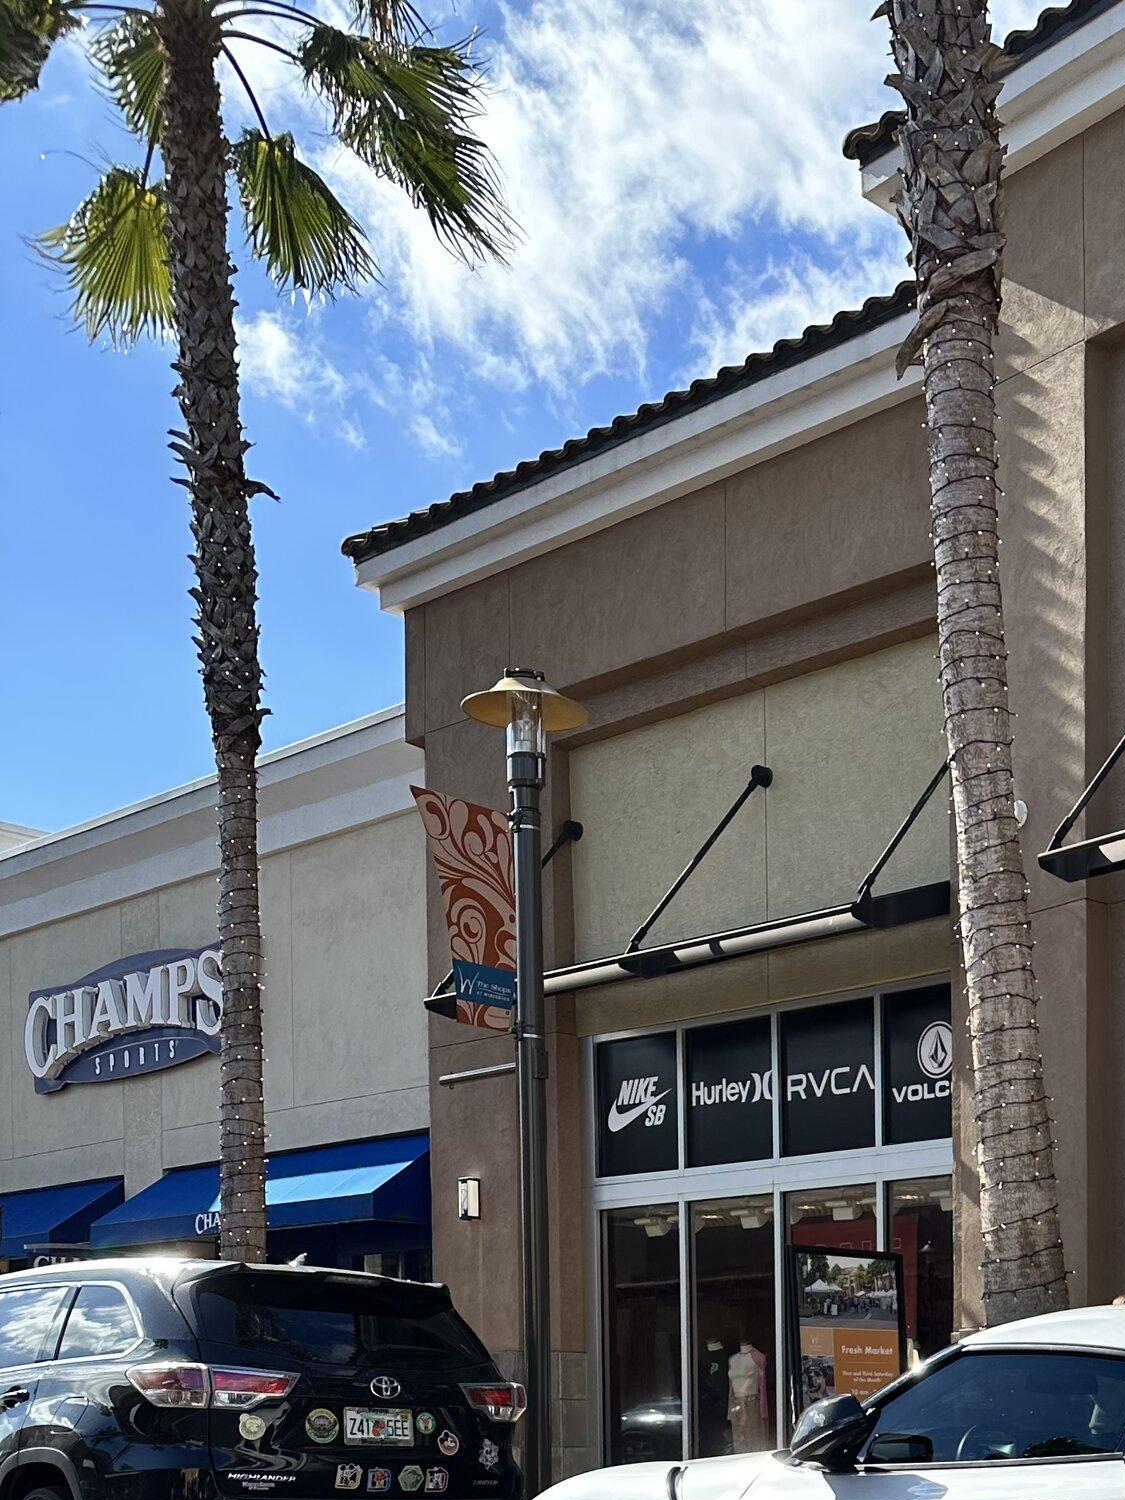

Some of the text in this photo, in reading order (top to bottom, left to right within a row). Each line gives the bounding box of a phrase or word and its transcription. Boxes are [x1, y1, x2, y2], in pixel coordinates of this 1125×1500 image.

[95, 1039, 176, 1075] SPORTS
[617, 1076, 659, 1106] NIKE
[692, 1078, 751, 1107] Hurley
[645, 1104, 667, 1127] SB
[841, 1344, 893, 1356] Fresh Market
[349, 1417, 370, 1435] Z41
[227, 1472, 297, 1482] HIGHLANDER
